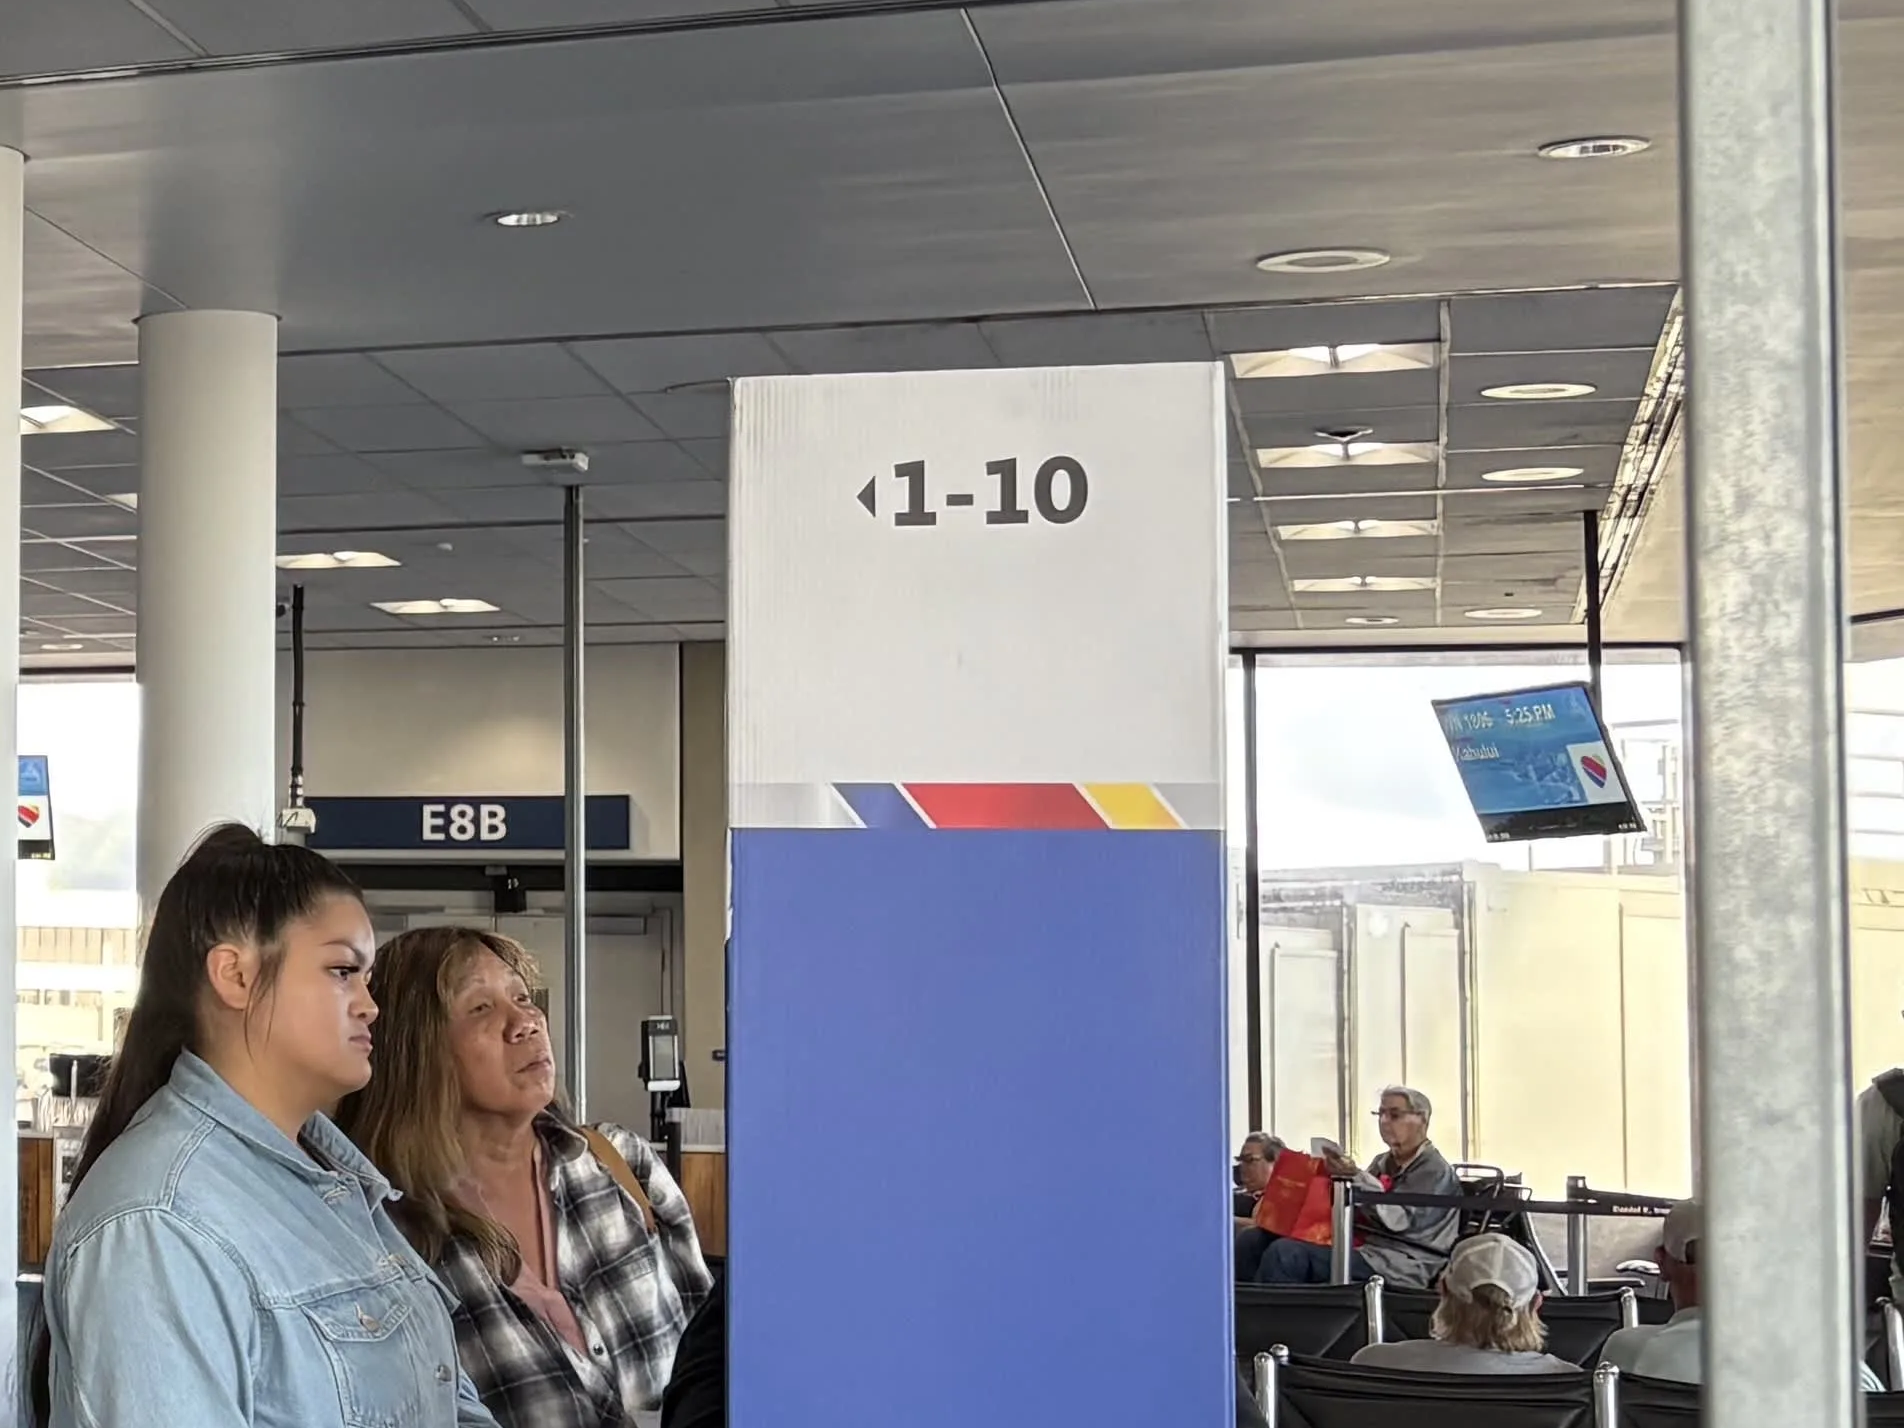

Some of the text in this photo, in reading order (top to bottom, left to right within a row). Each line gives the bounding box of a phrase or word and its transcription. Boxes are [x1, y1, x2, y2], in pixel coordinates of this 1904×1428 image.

[893, 455, 1089, 527] 1-10
[1504, 706, 1532, 725] 5:25
[1533, 703, 1556, 722] PM
[422, 803, 507, 841] E8B
